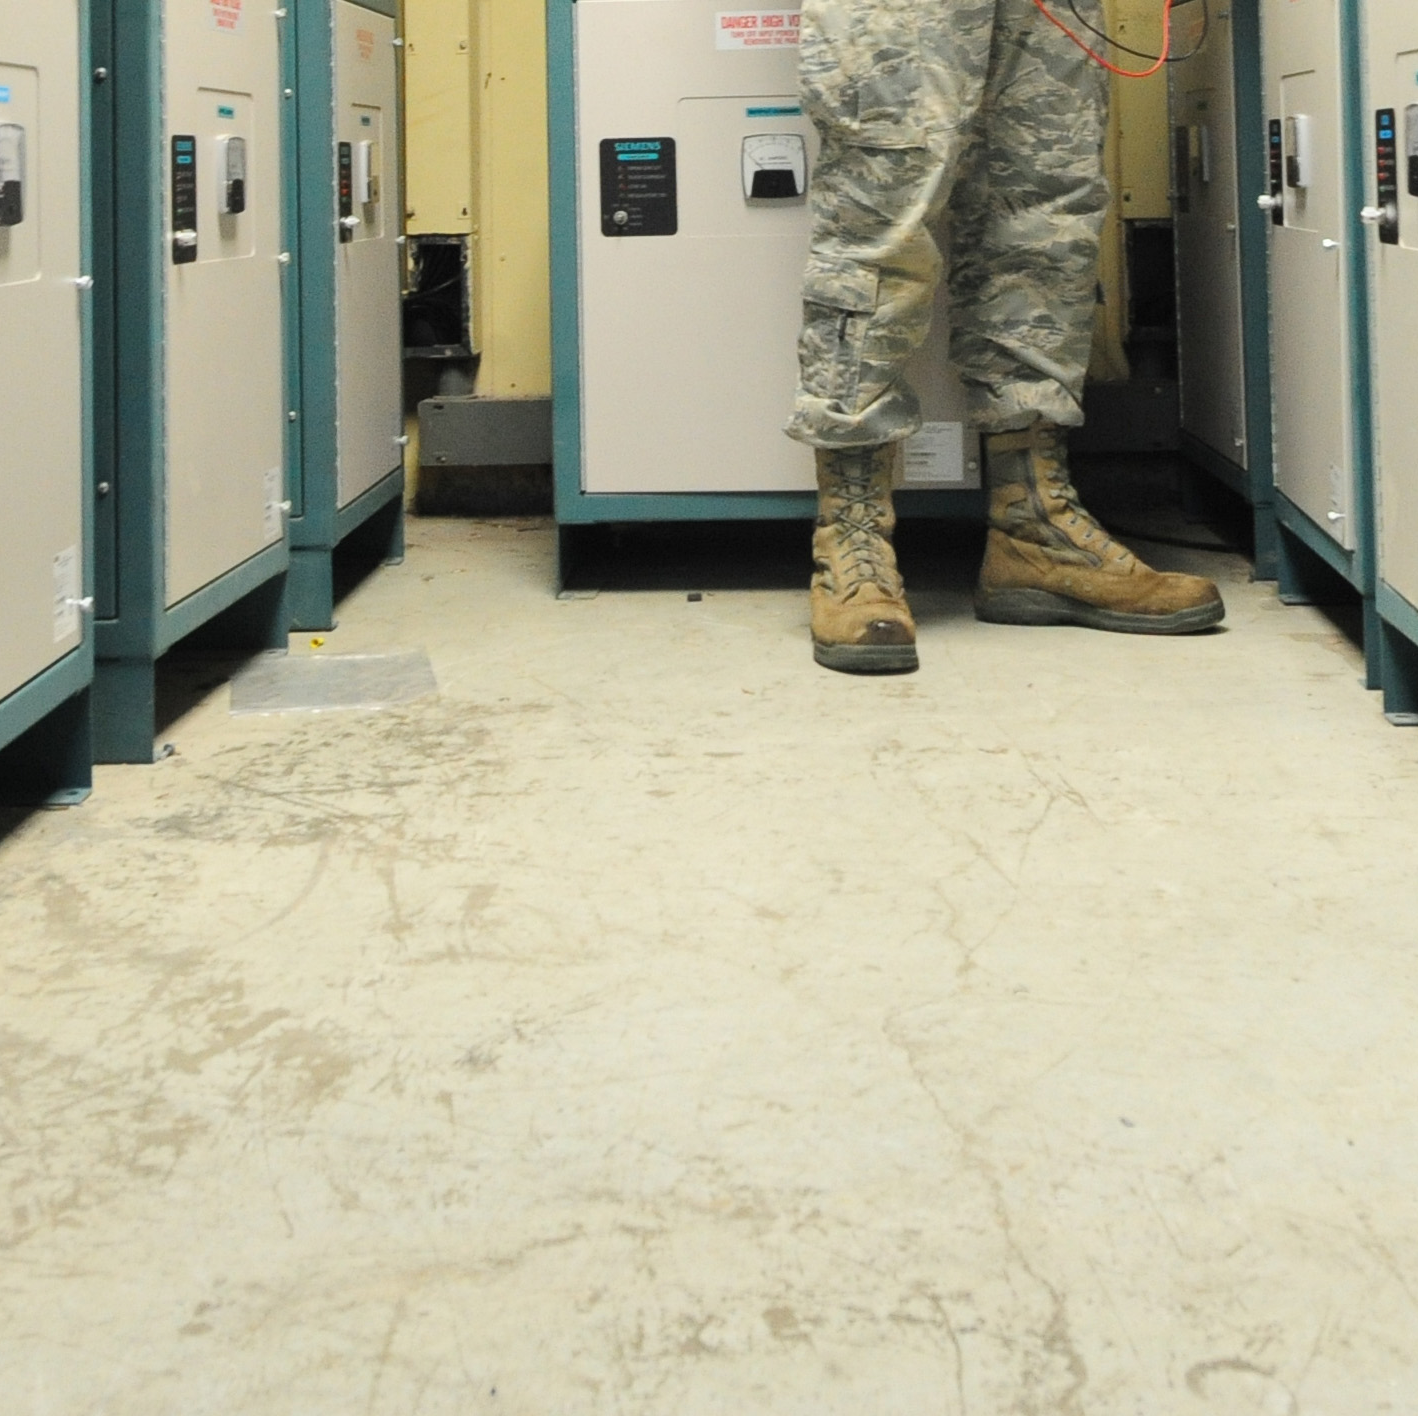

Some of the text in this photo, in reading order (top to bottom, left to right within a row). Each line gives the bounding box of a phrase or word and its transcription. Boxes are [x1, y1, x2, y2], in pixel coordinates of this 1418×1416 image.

[721, 16, 757, 29] DANGER
[762, 15, 784, 27] HIGH
[614, 141, 661, 151] SIEMENS
